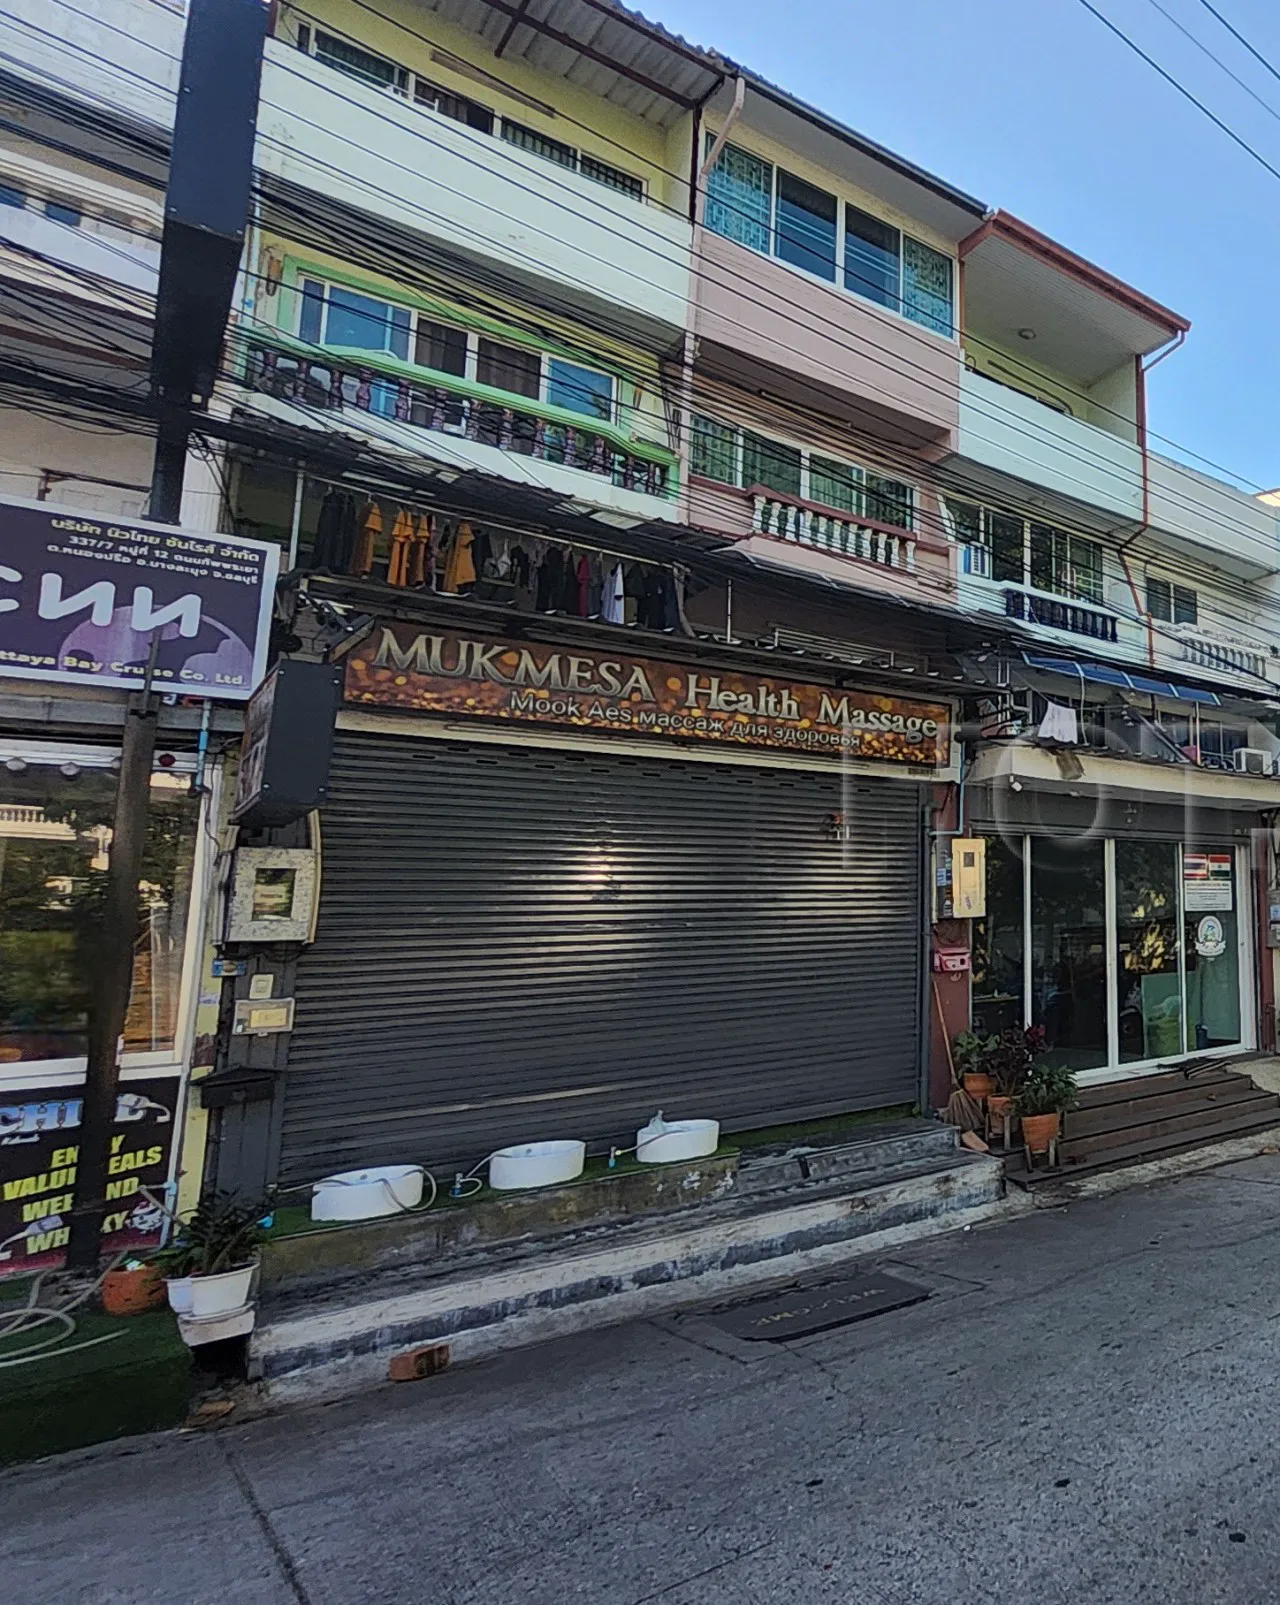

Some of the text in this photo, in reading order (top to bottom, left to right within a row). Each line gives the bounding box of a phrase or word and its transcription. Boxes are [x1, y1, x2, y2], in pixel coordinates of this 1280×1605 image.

[51, 518, 102, 535] บริษัท
[220, 546, 260, 562] จำกัด
[153, 549, 169, 559] 12
[63, 656, 103, 672] Bay
[110, 661, 174, 678] Cruse
[510, 690, 860, 748] Mook Aes массаж для здоровья
[684, 673, 801, 720] Health
[816, 692, 939, 744] Massage
